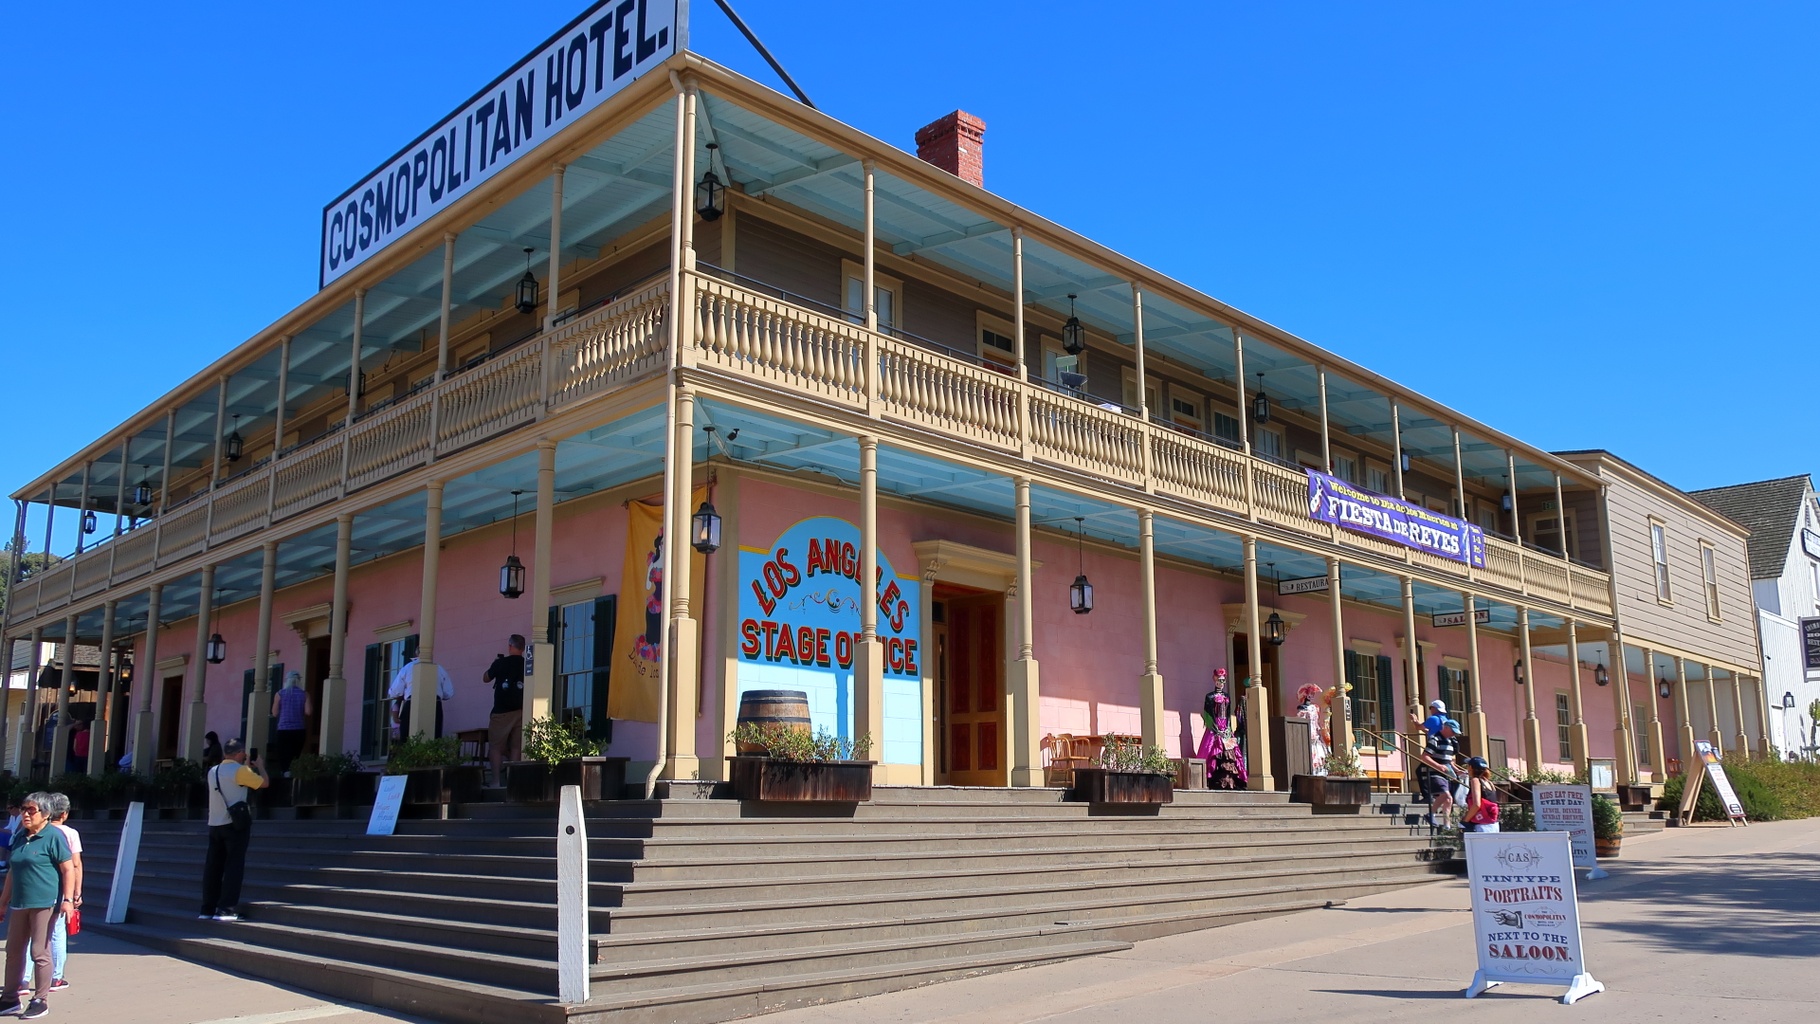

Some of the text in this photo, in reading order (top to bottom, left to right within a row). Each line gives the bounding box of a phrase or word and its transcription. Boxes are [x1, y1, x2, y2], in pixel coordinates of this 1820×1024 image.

[328, 0, 669, 271] COSMOPOLITAN HOTEL.
[1327, 479, 1370, 503] Welcome
[1370, 497, 1380, 506] to
[1395, 503, 1405, 513] de
[1406, 505, 1418, 518] los
[1418, 509, 1450, 528] Muertos
[1327, 495, 1461, 555] FIESTA DE REYES
[751, 547, 801, 617] LOS
[1296, 578, 1329, 592] RESTAURA
[1447, 611, 1488, 625] SALN.
[741, 618, 918, 677] STAGE OICE
[1539, 790, 1584, 800] KIDS EAT FREE
[1482, 875, 1561, 883] TINTYPE
[1483, 885, 1563, 904] PORTRAITS
[1488, 931, 1568, 945] NEXT TO THE
[1488, 943, 1573, 962] SALOON.
